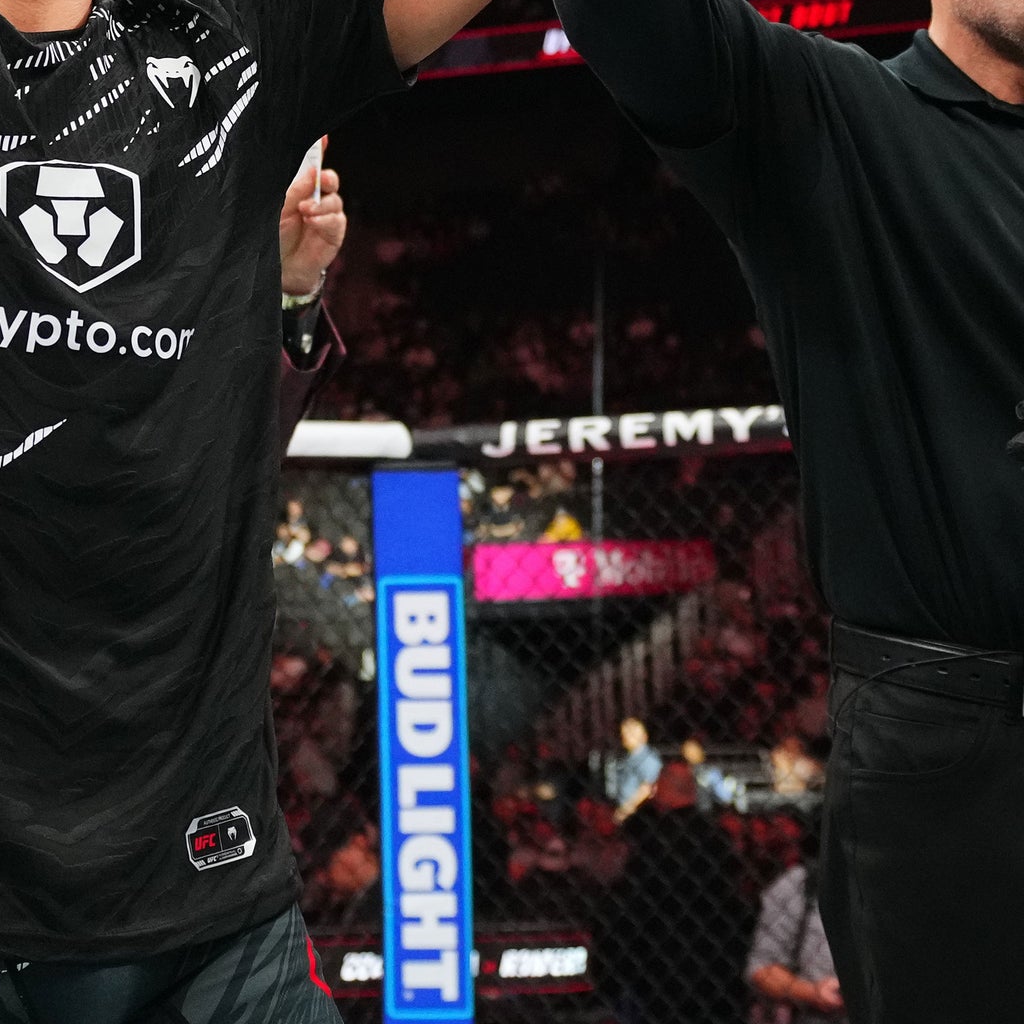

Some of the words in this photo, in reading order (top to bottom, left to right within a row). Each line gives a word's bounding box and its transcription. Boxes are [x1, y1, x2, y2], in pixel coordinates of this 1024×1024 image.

[481, 404, 790, 458] JEREMY'
[393, 590, 454, 758] BUD
[194, 832, 217, 852] UFC
[396, 763, 460, 1003] LIGHT
